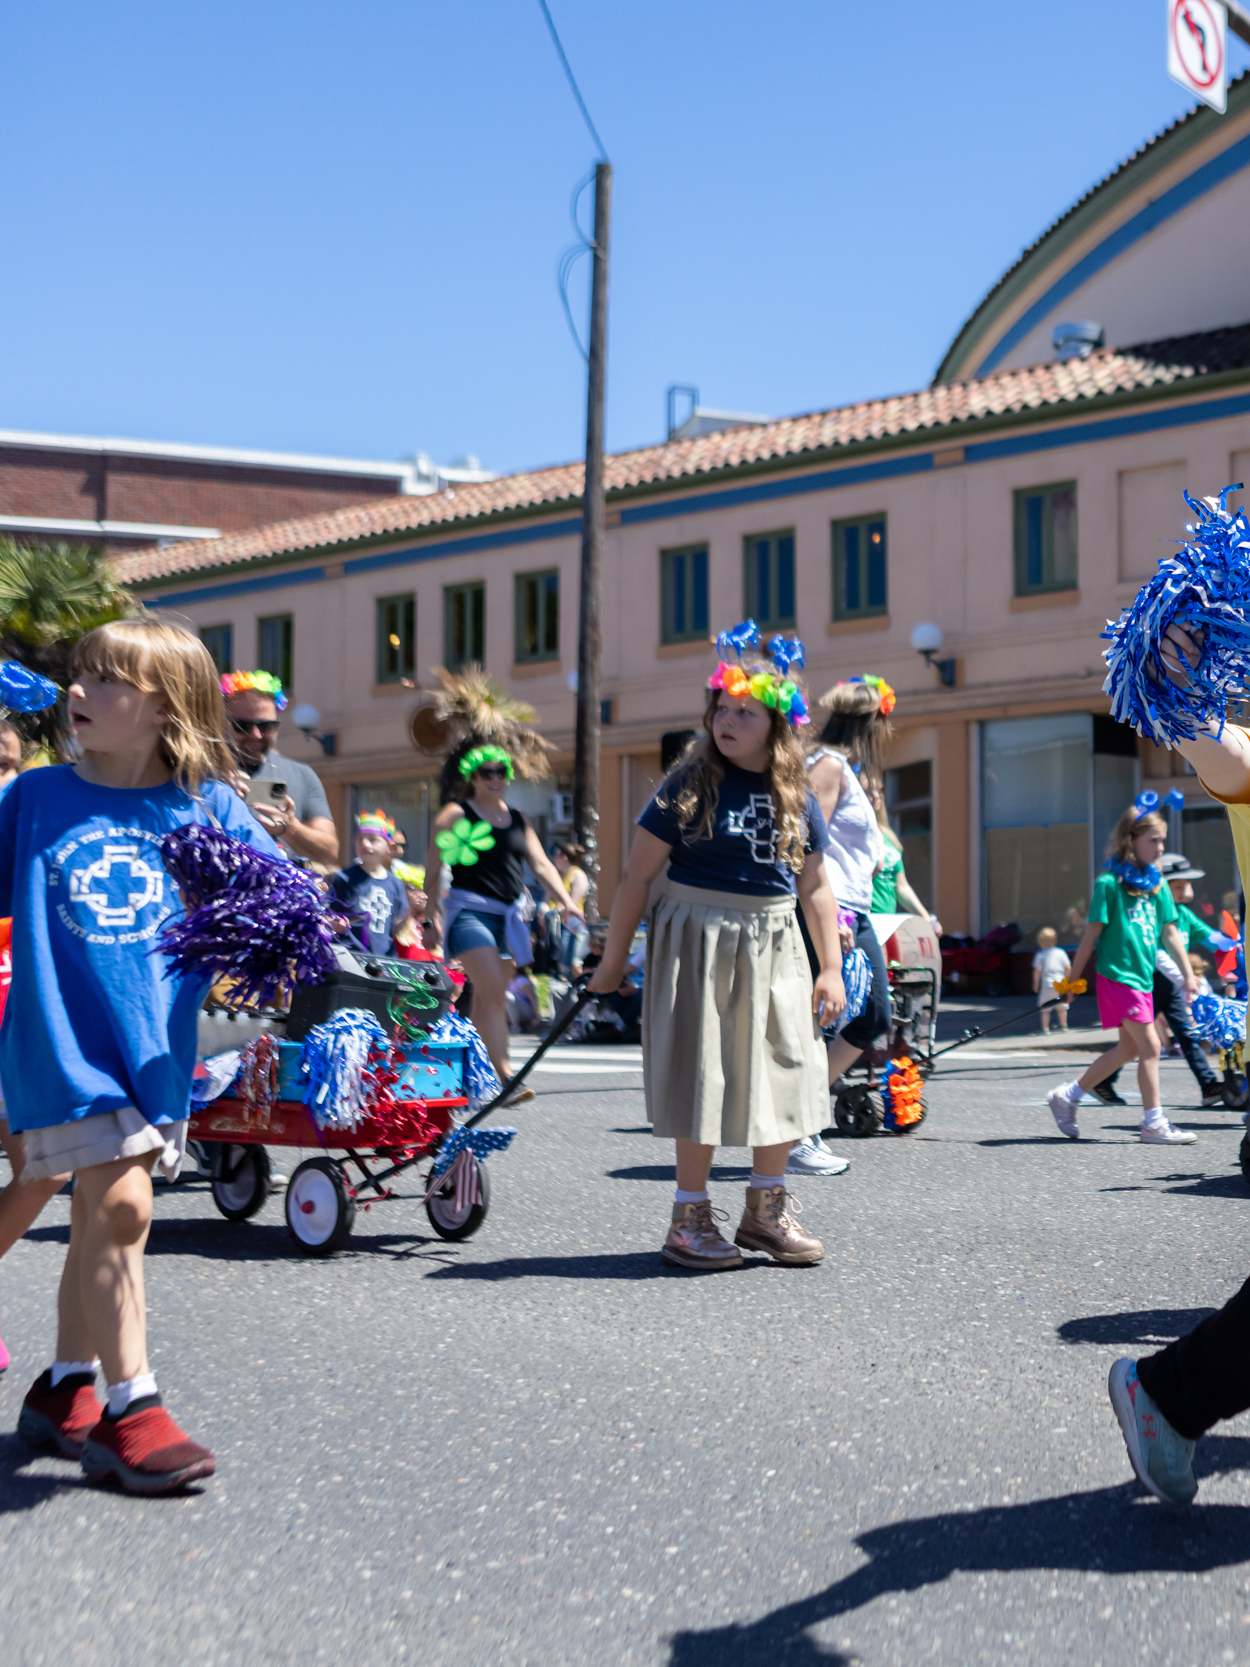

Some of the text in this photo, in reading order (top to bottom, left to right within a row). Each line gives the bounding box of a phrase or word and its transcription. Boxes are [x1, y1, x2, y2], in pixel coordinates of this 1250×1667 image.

[78, 830, 105, 844] THE
[107, 827, 166, 848] APOSTL
[86, 932, 116, 945] AND
[117, 906, 172, 944] SCHORS
